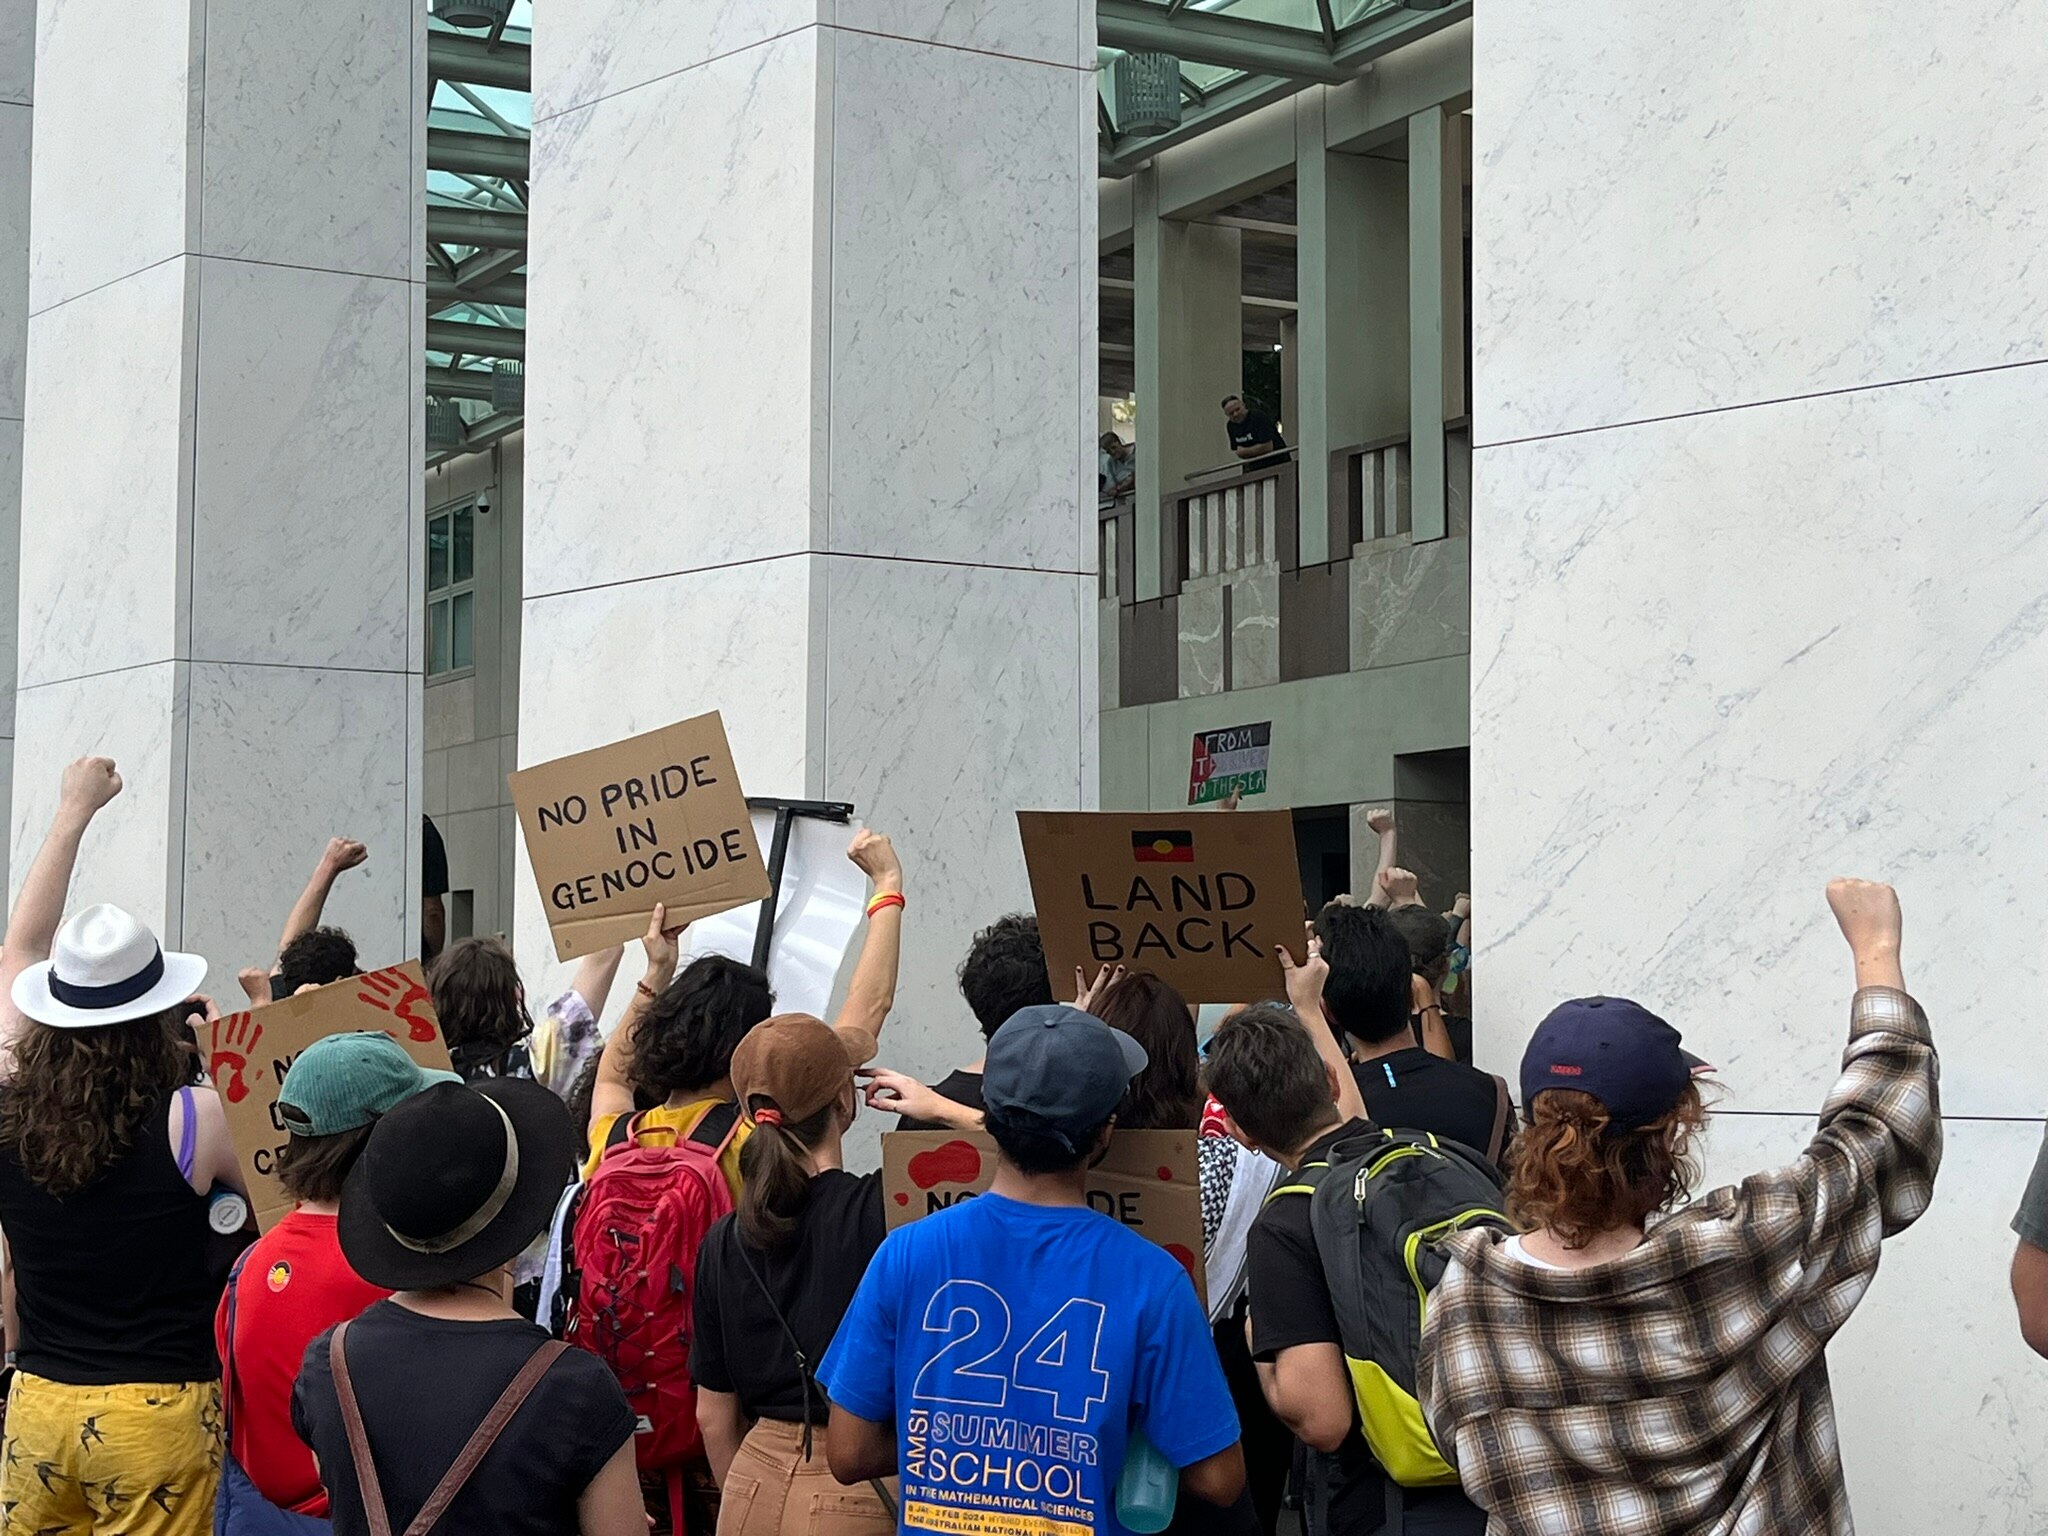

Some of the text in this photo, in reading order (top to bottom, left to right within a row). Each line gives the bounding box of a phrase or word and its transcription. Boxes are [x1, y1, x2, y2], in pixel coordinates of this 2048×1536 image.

[1205, 729, 1252, 757] FROM
[537, 755, 717, 832] NO PRIDE
[1192, 770, 1266, 801] TO THE SEA
[616, 817, 657, 854] IN
[551, 829, 747, 910] GENOCIDE
[1081, 872, 1256, 912] LAND
[1088, 917, 1264, 961] BACK
[912, 1279, 1109, 1423] 24
[906, 1408, 929, 1479] AMSI
[931, 1411, 1098, 1466] SUMMER
[928, 1448, 1095, 1504] SCHOOL
[905, 1484, 917, 1496] IN
[938, 1490, 1038, 1510] MATHEMATICAL
[1040, 1501, 1094, 1522] SCIENCES
[908, 1513, 924, 1524] THE
[942, 1510, 960, 1519] FEB
[963, 1512, 985, 1521] 2024
